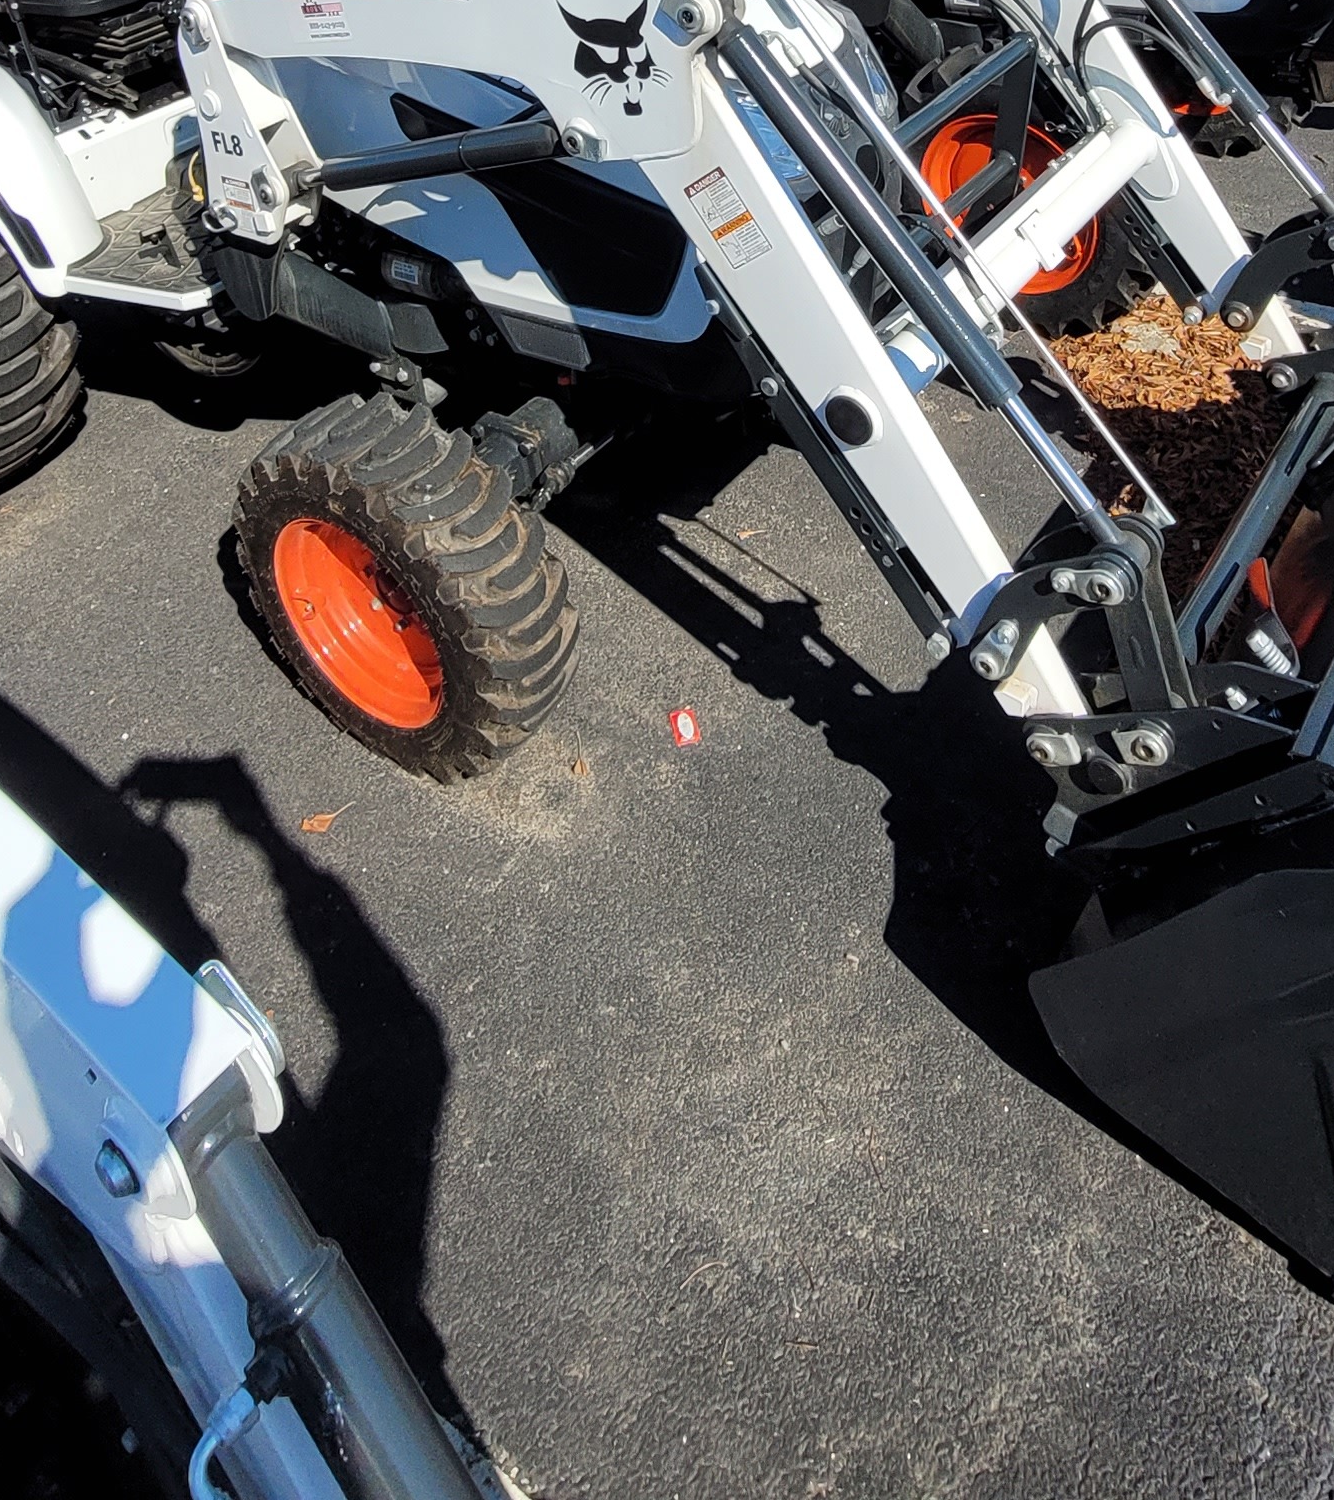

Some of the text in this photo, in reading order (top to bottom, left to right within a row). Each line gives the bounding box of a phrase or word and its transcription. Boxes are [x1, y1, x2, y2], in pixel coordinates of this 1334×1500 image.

[210, 130, 244, 157] FL8
[693, 170, 722, 192] DANGER
[720, 214, 749, 233] WARNING
